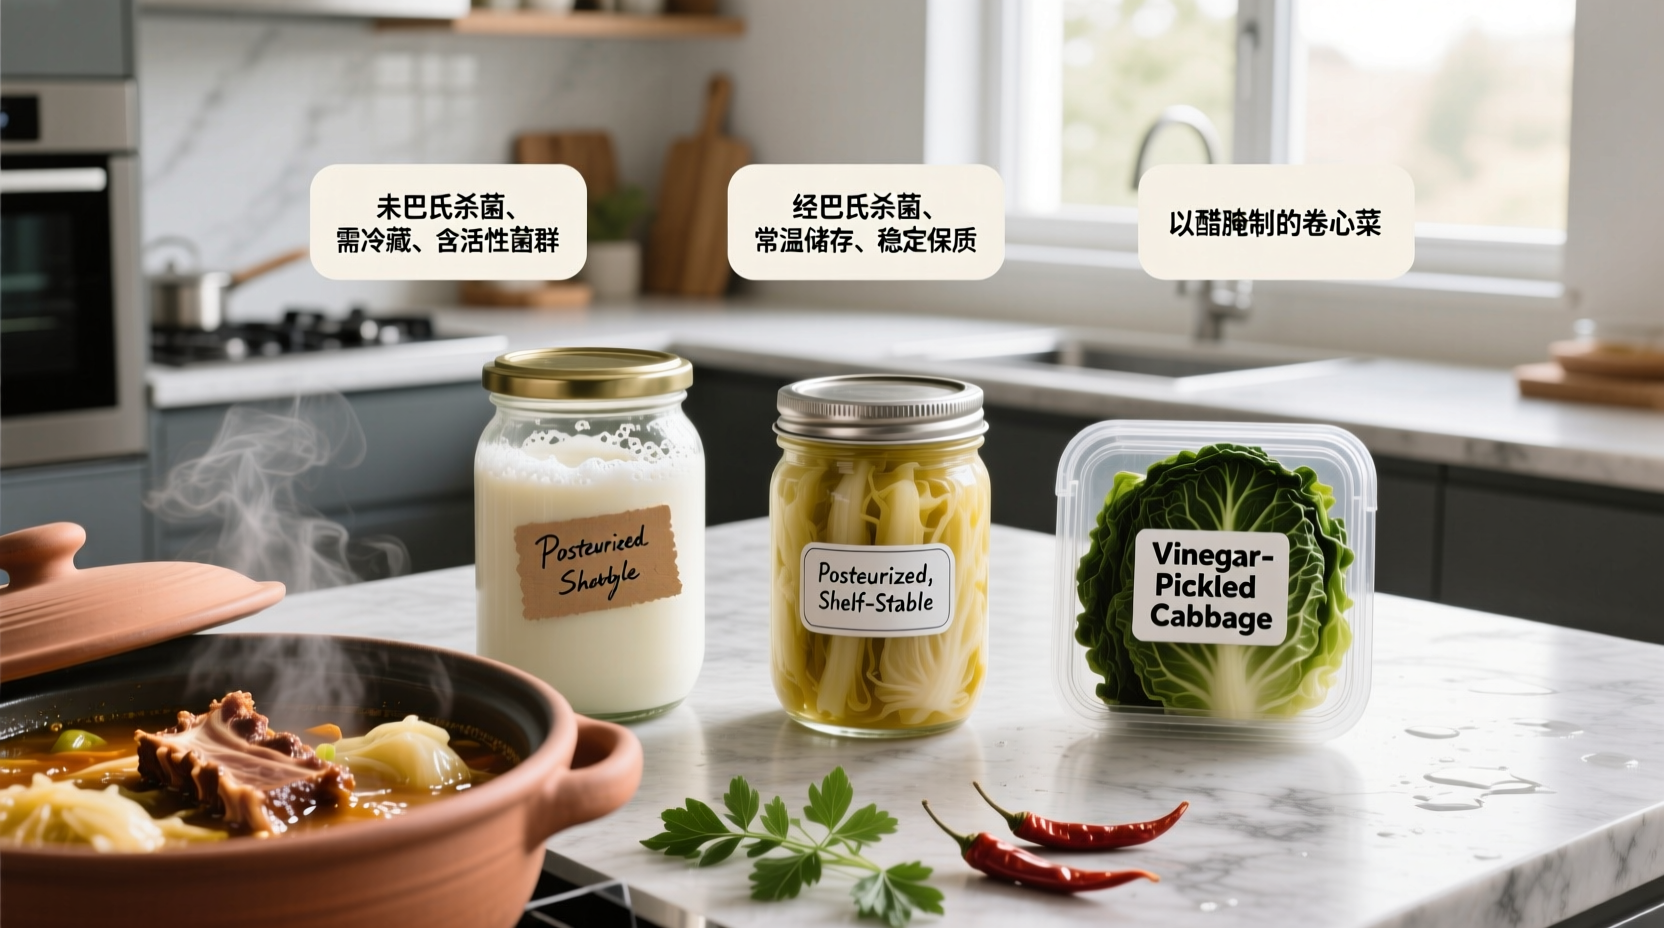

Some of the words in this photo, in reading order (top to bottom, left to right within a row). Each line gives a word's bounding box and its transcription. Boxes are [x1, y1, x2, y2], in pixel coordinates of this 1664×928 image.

[1152, 541, 1274, 573] Vinegar-
[818, 561, 933, 587] Posteurized,
[1155, 572, 1256, 599] Pickled
[818, 589, 934, 613] Shelf-Stable
[1150, 602, 1273, 637] Cabbage
